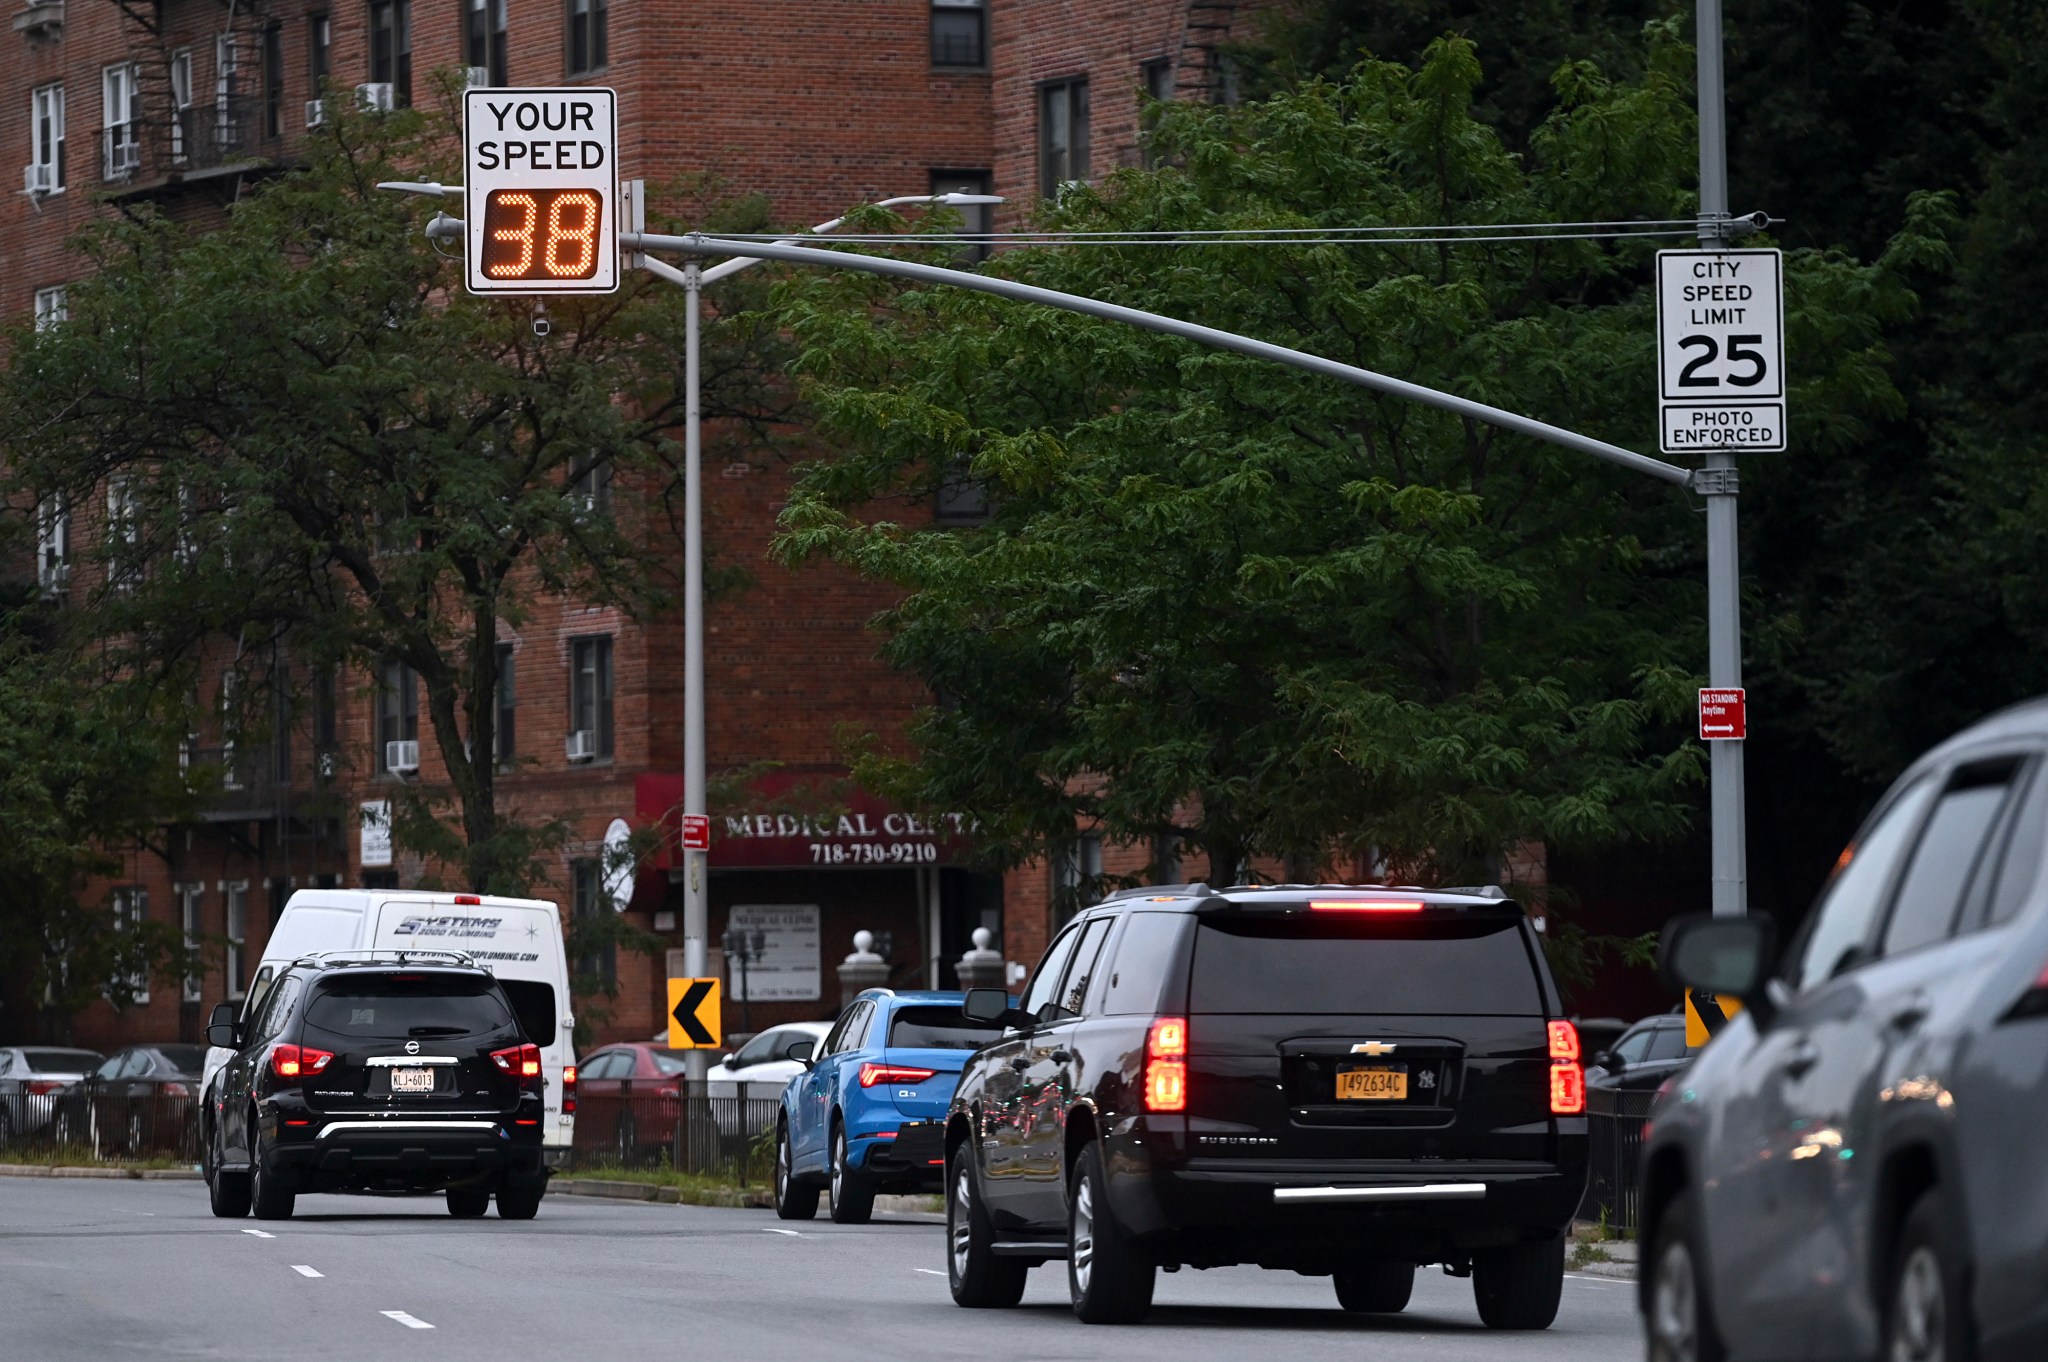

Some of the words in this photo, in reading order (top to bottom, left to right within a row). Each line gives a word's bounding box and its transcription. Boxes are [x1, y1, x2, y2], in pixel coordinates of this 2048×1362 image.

[487, 102, 594, 131] YOUR
[477, 141, 604, 170] SPEED
[491, 194, 597, 276] 38
[1693, 262, 1741, 278] CITY
[1683, 285, 1752, 301] SPEED
[1691, 308, 1746, 324] LIMIT
[1677, 334, 1767, 387] 25
[1692, 411, 1753, 426] PHOTO
[1674, 428, 1772, 443] ENFORCED
[1702, 694, 1710, 703] NO
[1711, 694, 1738, 703] STANDING
[1703, 705, 1726, 717] Anytime
[810, 843, 937, 864] 718-730-9210
[418, 928, 447, 936] 2000
[448, 929, 497, 939] PLUMBING
[1342, 1074, 1400, 1092] T492634C
[1199, 1136, 1278, 1145] SUBURBAN
